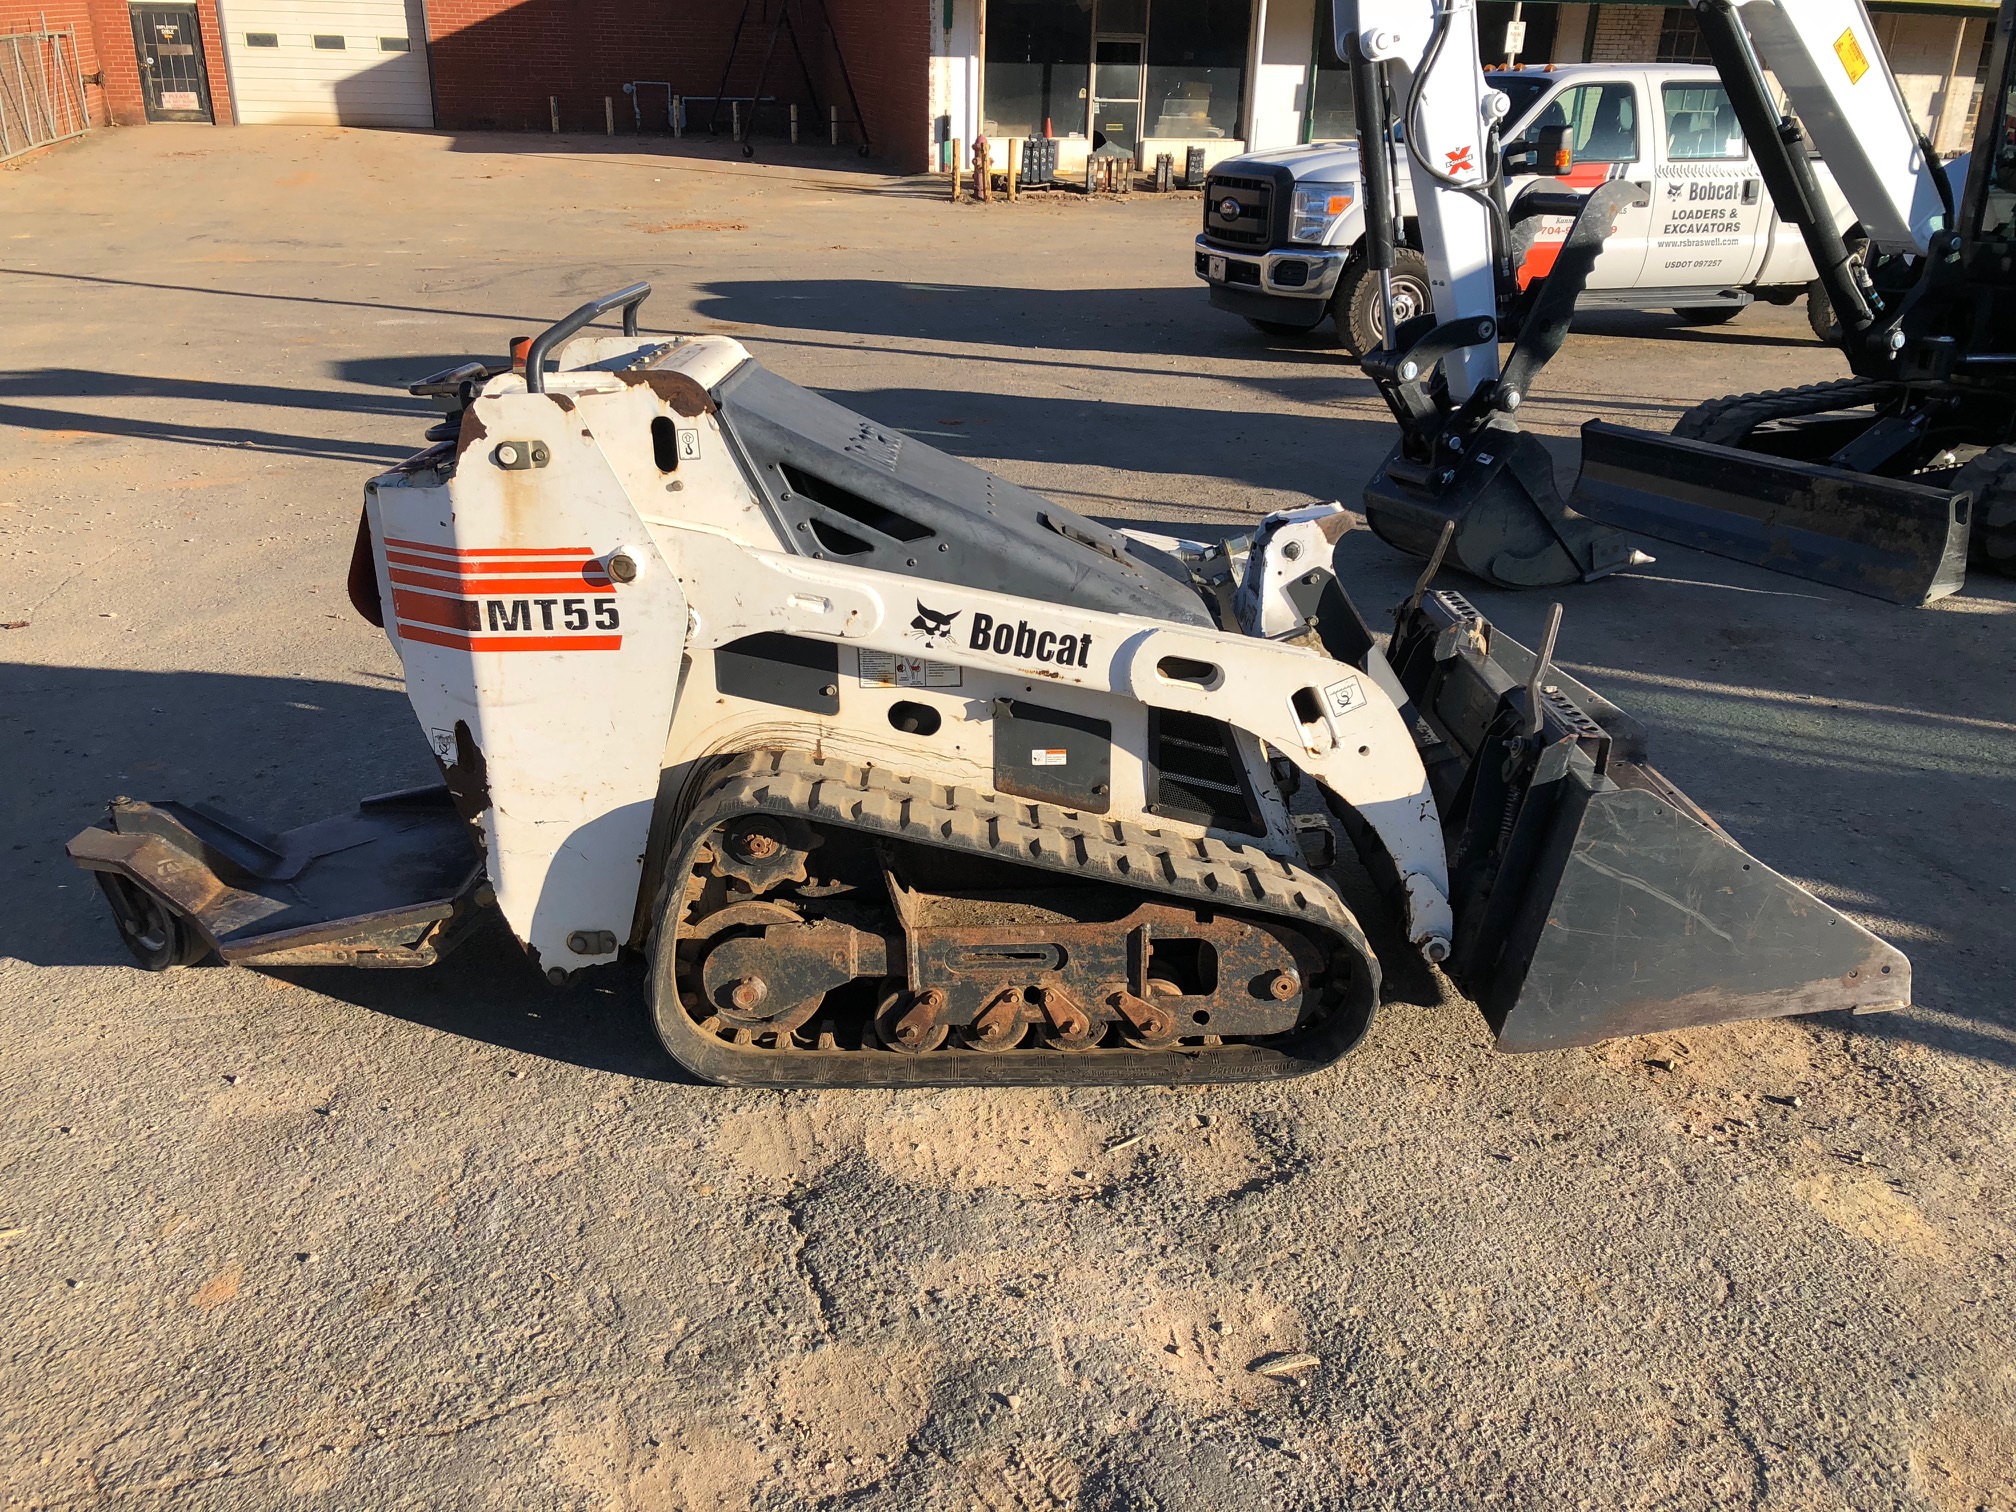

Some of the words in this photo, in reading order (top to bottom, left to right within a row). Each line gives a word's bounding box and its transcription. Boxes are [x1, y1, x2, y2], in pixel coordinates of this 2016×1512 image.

[1689, 181, 1739, 201] Bobcat
[1671, 209, 1726, 221] LOADERS
[1729, 208, 1739, 219] &
[1663, 221, 1741, 235] EXCAVATORS
[1657, 237, 1739, 248] www.rsbraswell.com
[1664, 260, 1693, 269] USDOT
[1693, 259, 1722, 268] 097257
[486, 598, 620, 632] MT55
[969, 611, 1092, 669] Bobcat
